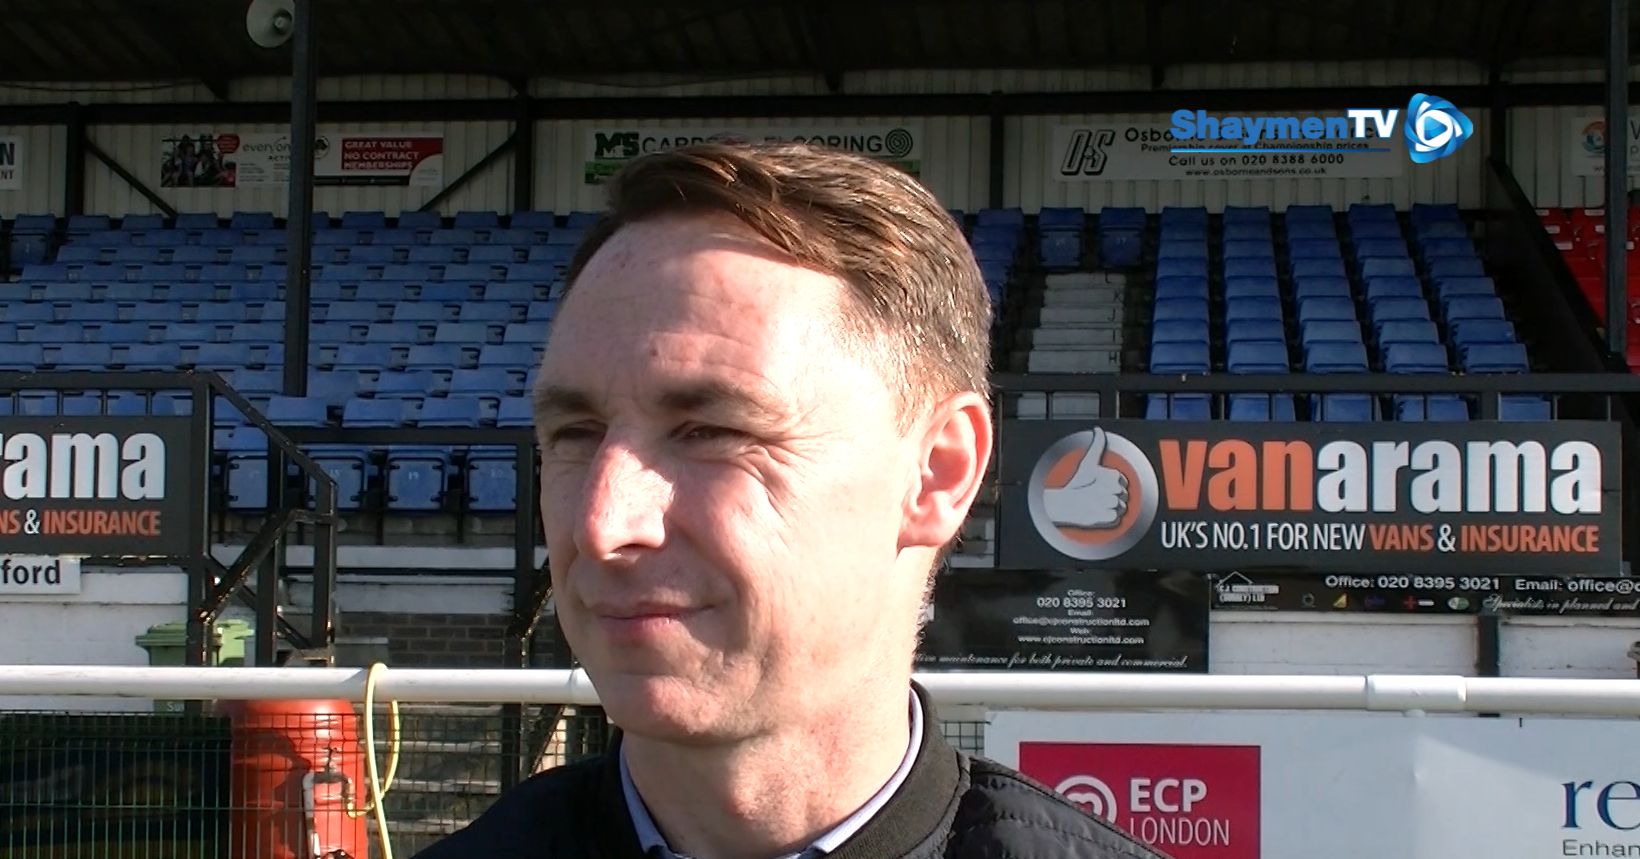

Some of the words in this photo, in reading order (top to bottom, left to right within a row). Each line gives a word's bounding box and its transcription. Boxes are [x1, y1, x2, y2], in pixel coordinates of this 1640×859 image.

[344, 141, 379, 149] GREAT
[380, 141, 413, 149] VALUE
[344, 151, 361, 160] NO
[362, 151, 419, 160] CONTRACT
[1168, 155, 1195, 166] Call
[1201, 157, 1215, 166] us
[1220, 157, 1236, 166] on
[1242, 155, 1267, 166] 020
[1272, 154, 1305, 165] 8388
[1311, 153, 1344, 164] 6000
[0, 432, 166, 500] ama
[1159, 439, 1602, 514] vanarama
[24, 509, 41, 535] &
[42, 511, 161, 537] INSURANCE
[1268, 523, 1309, 551] FOR
[1314, 523, 1366, 551] NEW
[1369, 524, 1432, 552] VANS
[1438, 523, 1456, 552] &
[1461, 524, 1600, 553] INSURANCE
[1325, 575, 1375, 588] Office:
[1377, 575, 1410, 588] 020
[1413, 576, 1456, 589] 8395
[1459, 577, 1500, 590] 3021
[1515, 578, 1563, 592] Email:
[1036, 597, 1060, 608] 020
[1063, 597, 1094, 608] 8395
[1096, 597, 1127, 609] 3021
[1547, 599, 1560, 609] in
[1558, 596, 1614, 614] planned
[1096, 653, 1122, 666] and
[1130, 777, 1208, 813] ECP
[1130, 816, 1230, 847] LONDON
